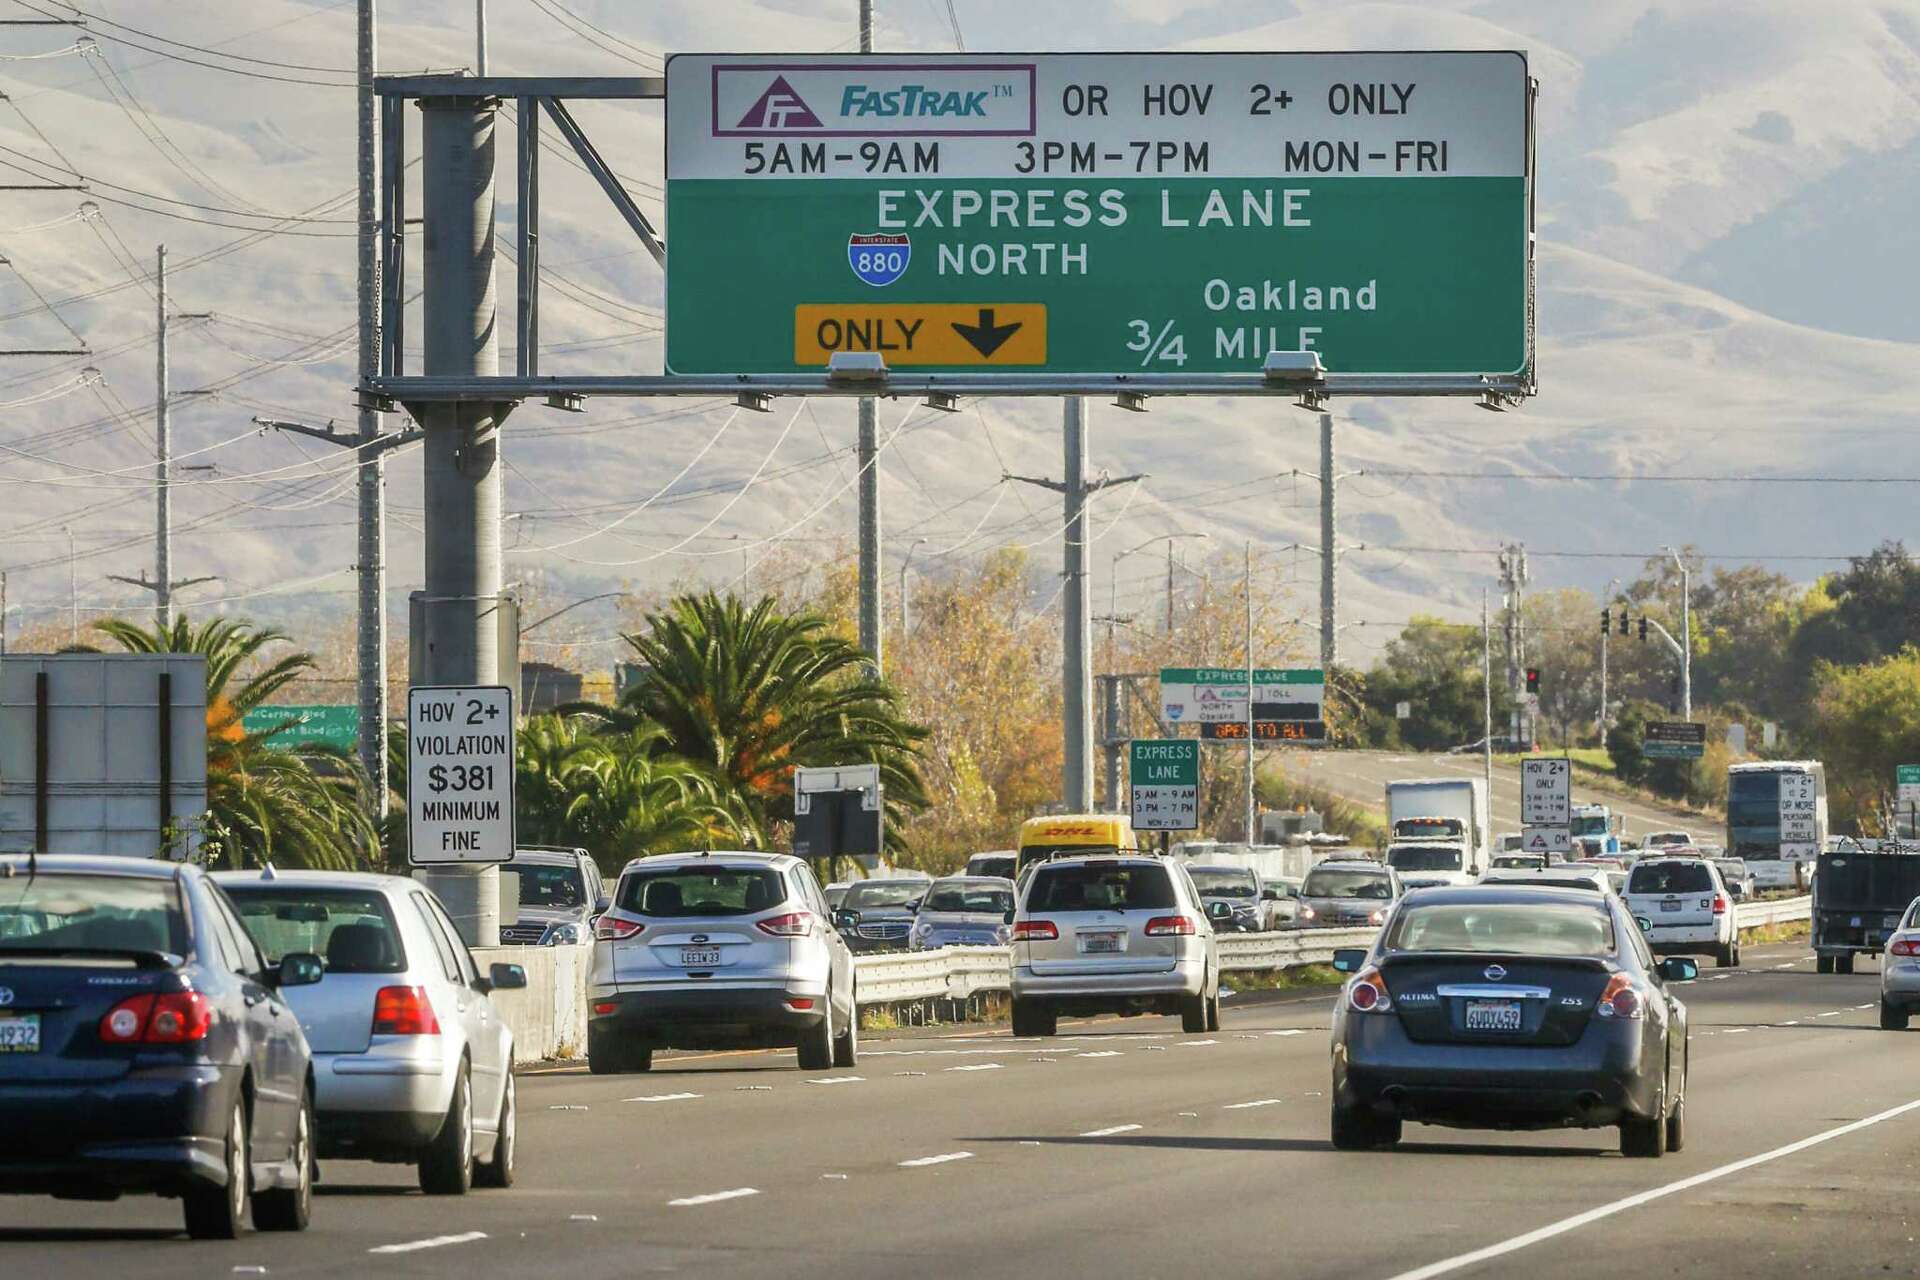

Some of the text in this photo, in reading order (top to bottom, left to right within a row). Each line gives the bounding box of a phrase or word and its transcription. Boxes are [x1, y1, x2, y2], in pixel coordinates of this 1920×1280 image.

[1062, 84, 1109, 116] OR
[1143, 84, 1213, 116] HOV
[1249, 83, 1293, 115] 2+
[1328, 83, 1416, 115] ONLY
[1285, 140, 1448, 172] MON-FRI
[878, 189, 1311, 228] EXPRESS LANE
[858, 243, 1087, 275] 880 NORTH
[1204, 279, 1377, 311] Oakland
[817, 319, 924, 350] ONLY
[1256, 672, 1288, 681] LANE
[420, 699, 499, 725] HOV 2+
[1256, 723, 1277, 738] TO
[416, 735, 505, 756] VIOLATION
[1136, 745, 1193, 760] EXPRESS
[1148, 765, 1180, 779] LANE
[1527, 762, 1564, 775] HOV 2+
[428, 764, 493, 794] $381
[1536, 779, 1555, 789] ONLY
[1783, 776, 1811, 785] HOV 2+
[1135, 790, 1141, 799] 5
[1145, 790, 1157, 799] AM
[1171, 790, 1178, 798] 9
[1181, 790, 1195, 799] AM
[1800, 789, 1807, 798] 2
[422, 801, 500, 821] MINIMUM
[1136, 804, 1142, 812] 3
[1145, 803, 1158, 812] PM
[1171, 803, 1177, 812] 7
[1181, 803, 1193, 812] PM
[1783, 800, 1814, 810] OR MORE
[1044, 827, 1096, 836] DHL
[442, 831, 480, 850] FINE
[1555, 834, 1567, 845] OK
[1400, 993, 1436, 1001] ALTIMA
